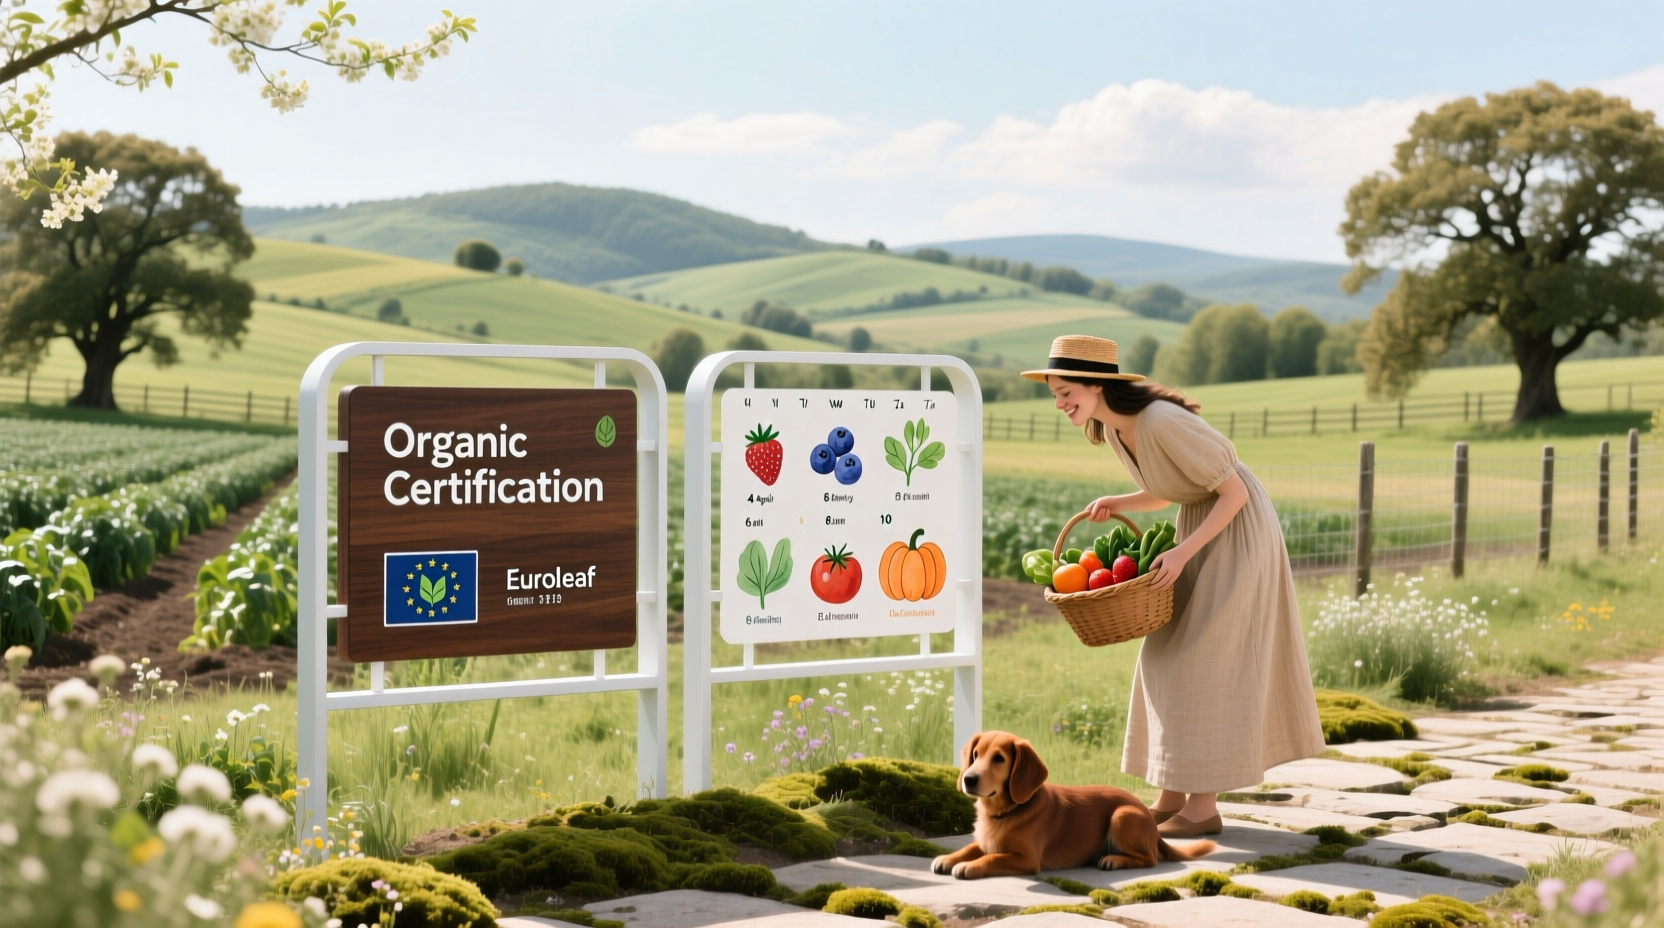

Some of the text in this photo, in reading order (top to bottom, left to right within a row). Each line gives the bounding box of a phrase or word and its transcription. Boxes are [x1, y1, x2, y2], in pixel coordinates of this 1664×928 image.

[383, 421, 528, 469] Organic
[383, 467, 604, 506] Certification
[747, 493, 754, 504] 4
[880, 513, 892, 525] 10
[506, 565, 597, 590] Euroleaf
